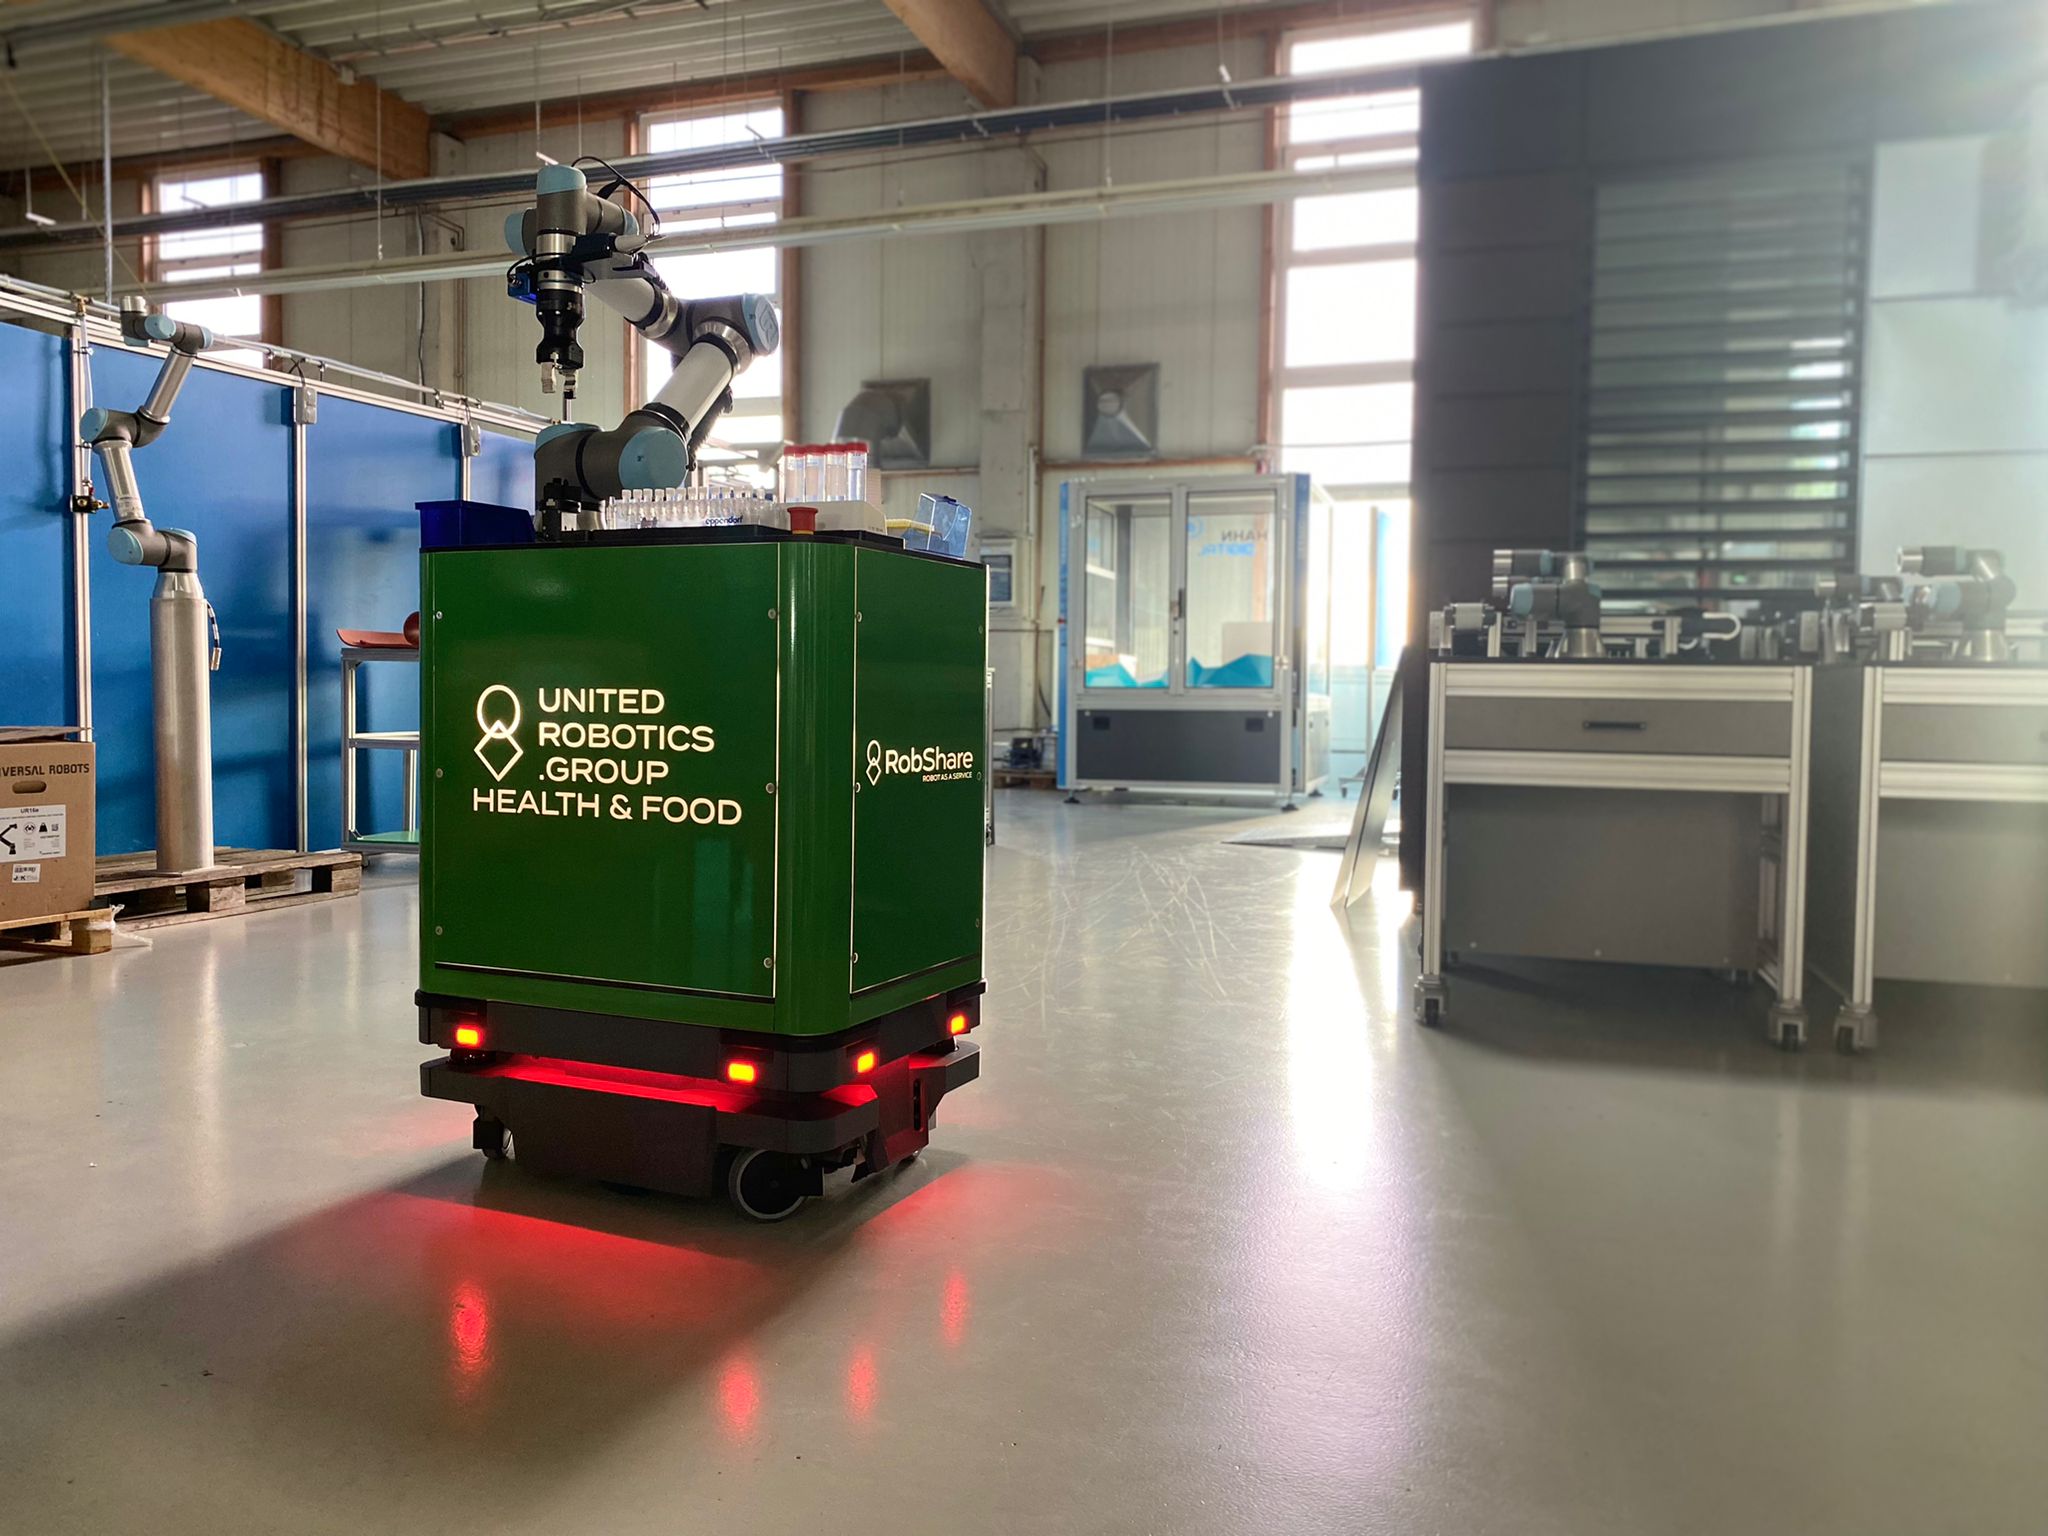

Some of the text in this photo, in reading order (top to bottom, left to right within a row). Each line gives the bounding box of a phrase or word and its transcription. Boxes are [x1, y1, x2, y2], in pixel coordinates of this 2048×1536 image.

[705, 514, 744, 527] eppendorf
[538, 687, 665, 714] UNITED
[538, 721, 715, 752] ROBOTICS
[0, 763, 90, 777] VERSAL ROBOTS
[539, 756, 669, 785] .GROUP
[885, 746, 973, 774] RobShare
[922, 774, 941, 782] ROBOT
[953, 771, 973, 780] SERVICE
[473, 788, 742, 825] HEALTH & FOOD
